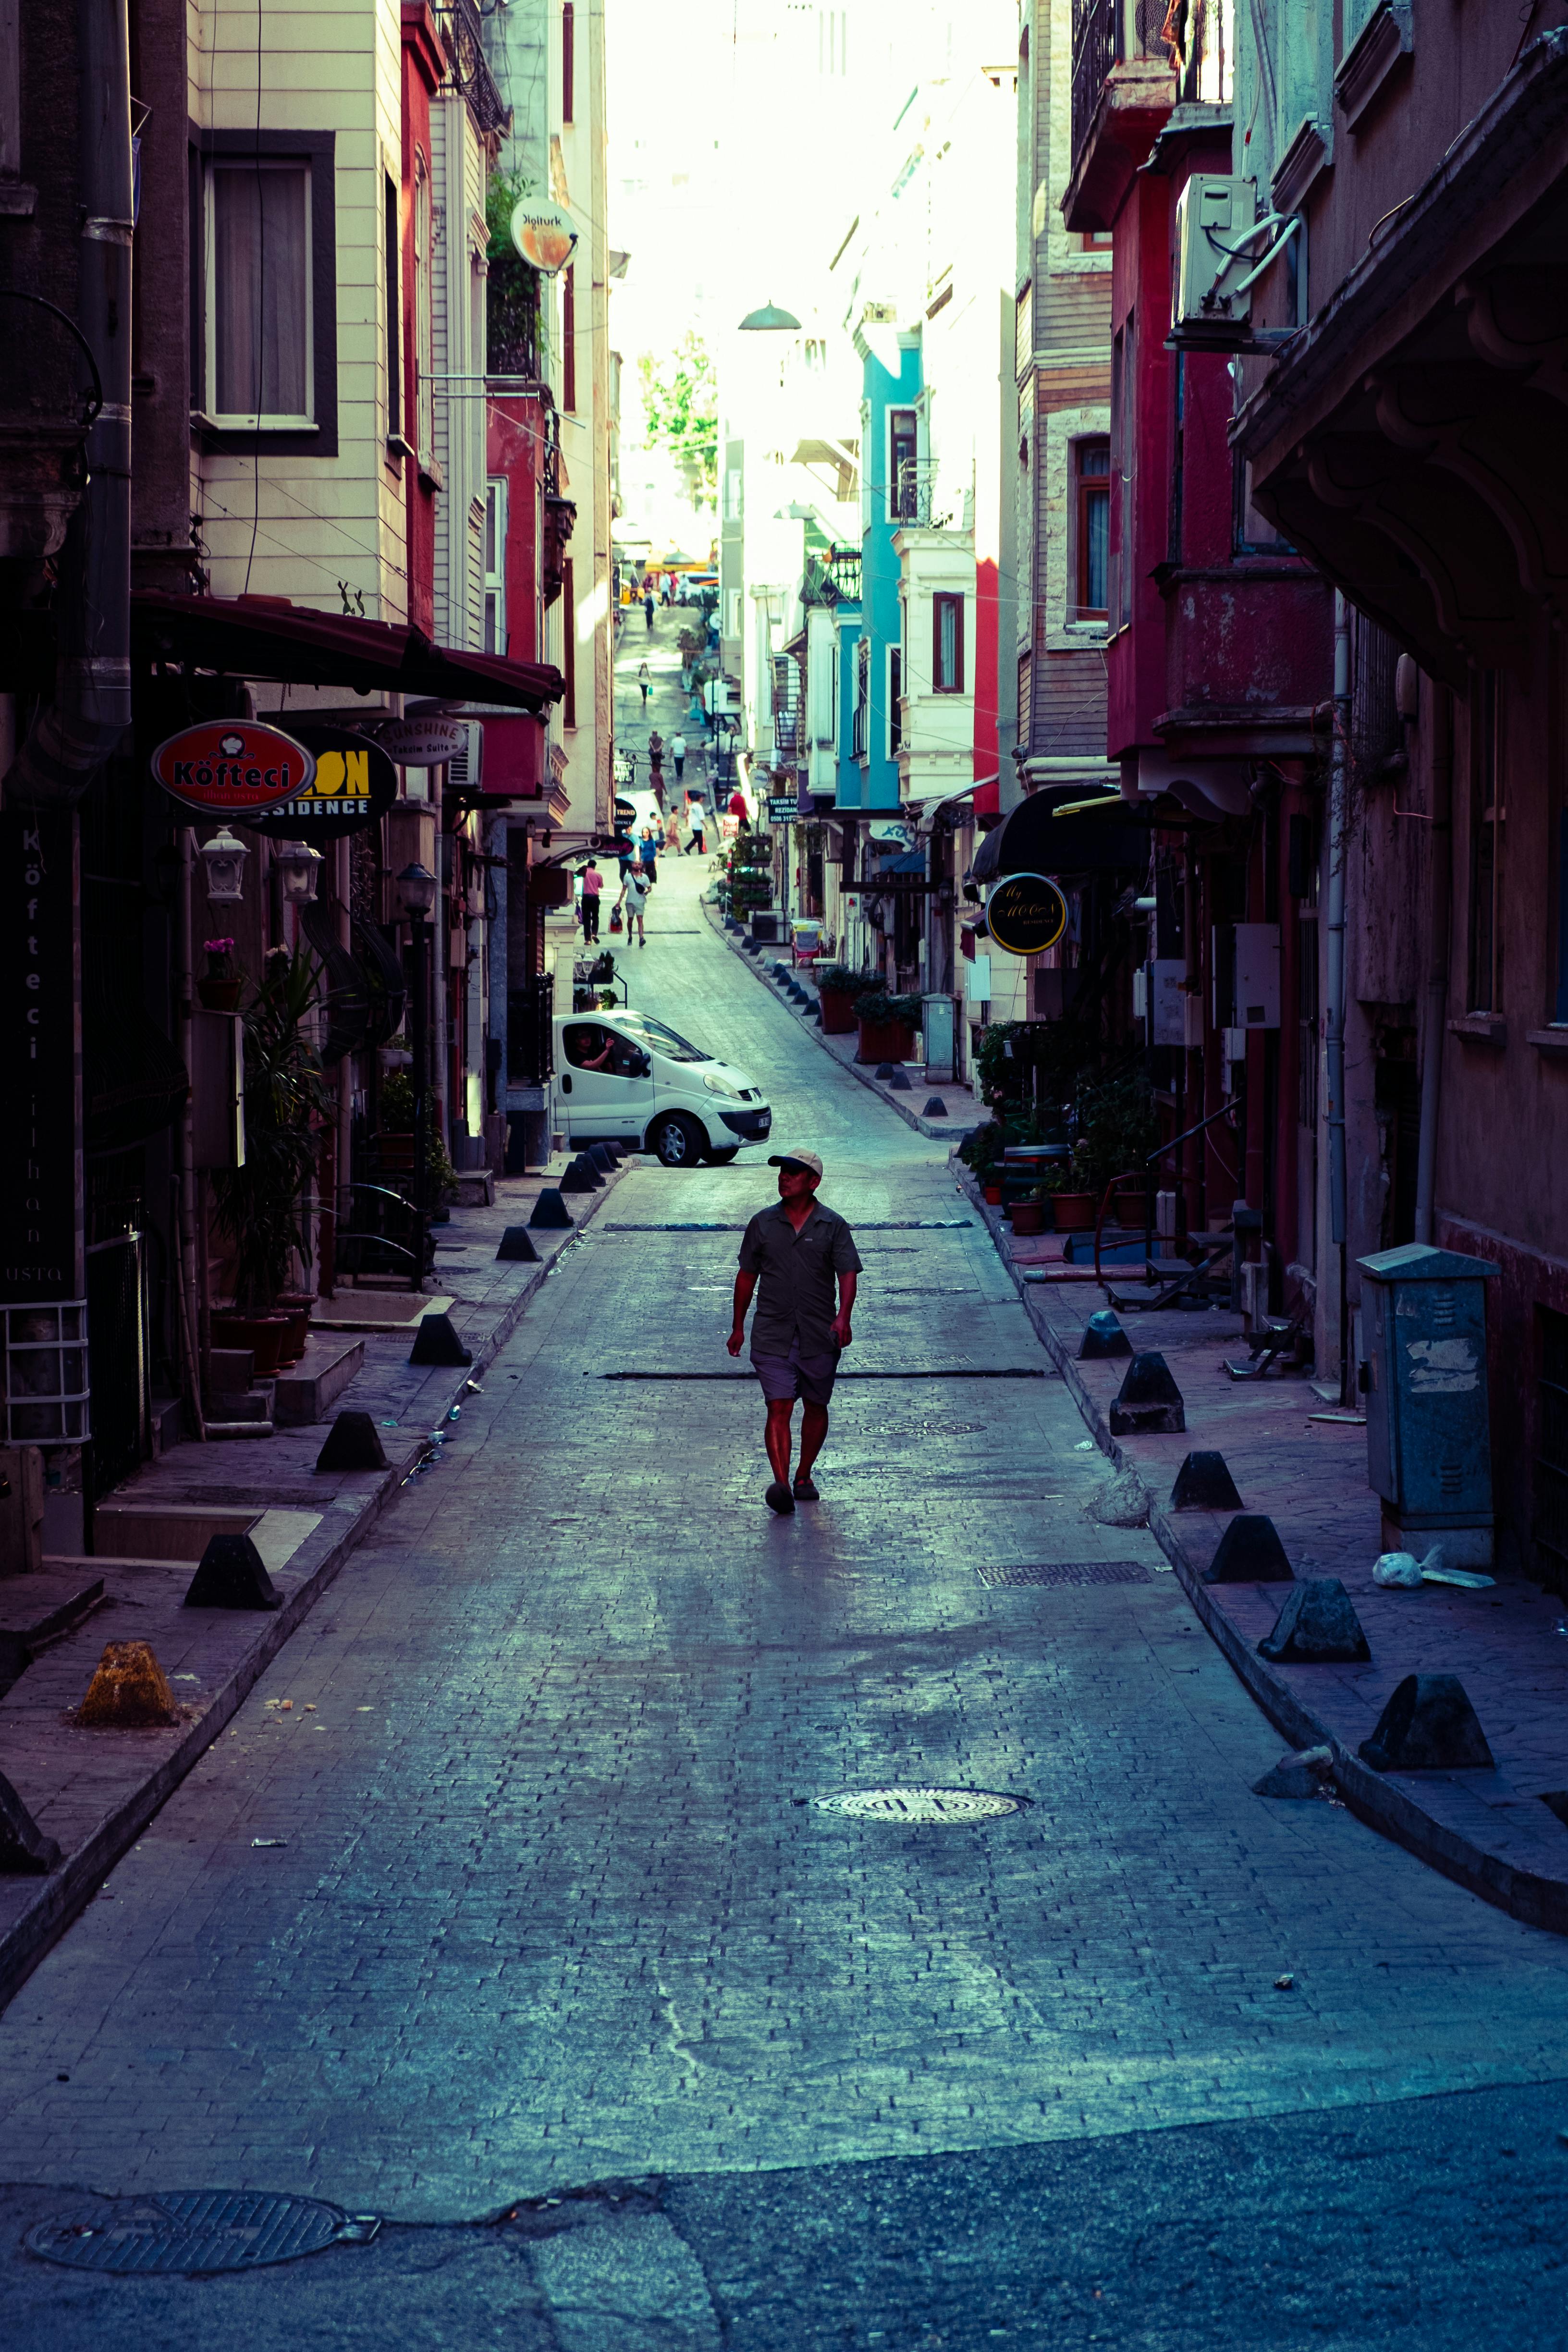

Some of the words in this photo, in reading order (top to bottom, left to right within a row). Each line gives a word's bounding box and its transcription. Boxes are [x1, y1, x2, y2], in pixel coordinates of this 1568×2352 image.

[383, 722, 458, 743] SUNSHINE
[393, 745, 423, 754] Taksim
[427, 744, 449, 752] Suite
[173, 760, 289, 788] Köfteci
[996, 884, 1022, 901] My
[23, 830, 41, 1060] Köfteci
[25, 1093, 41, 1243] ilhan
